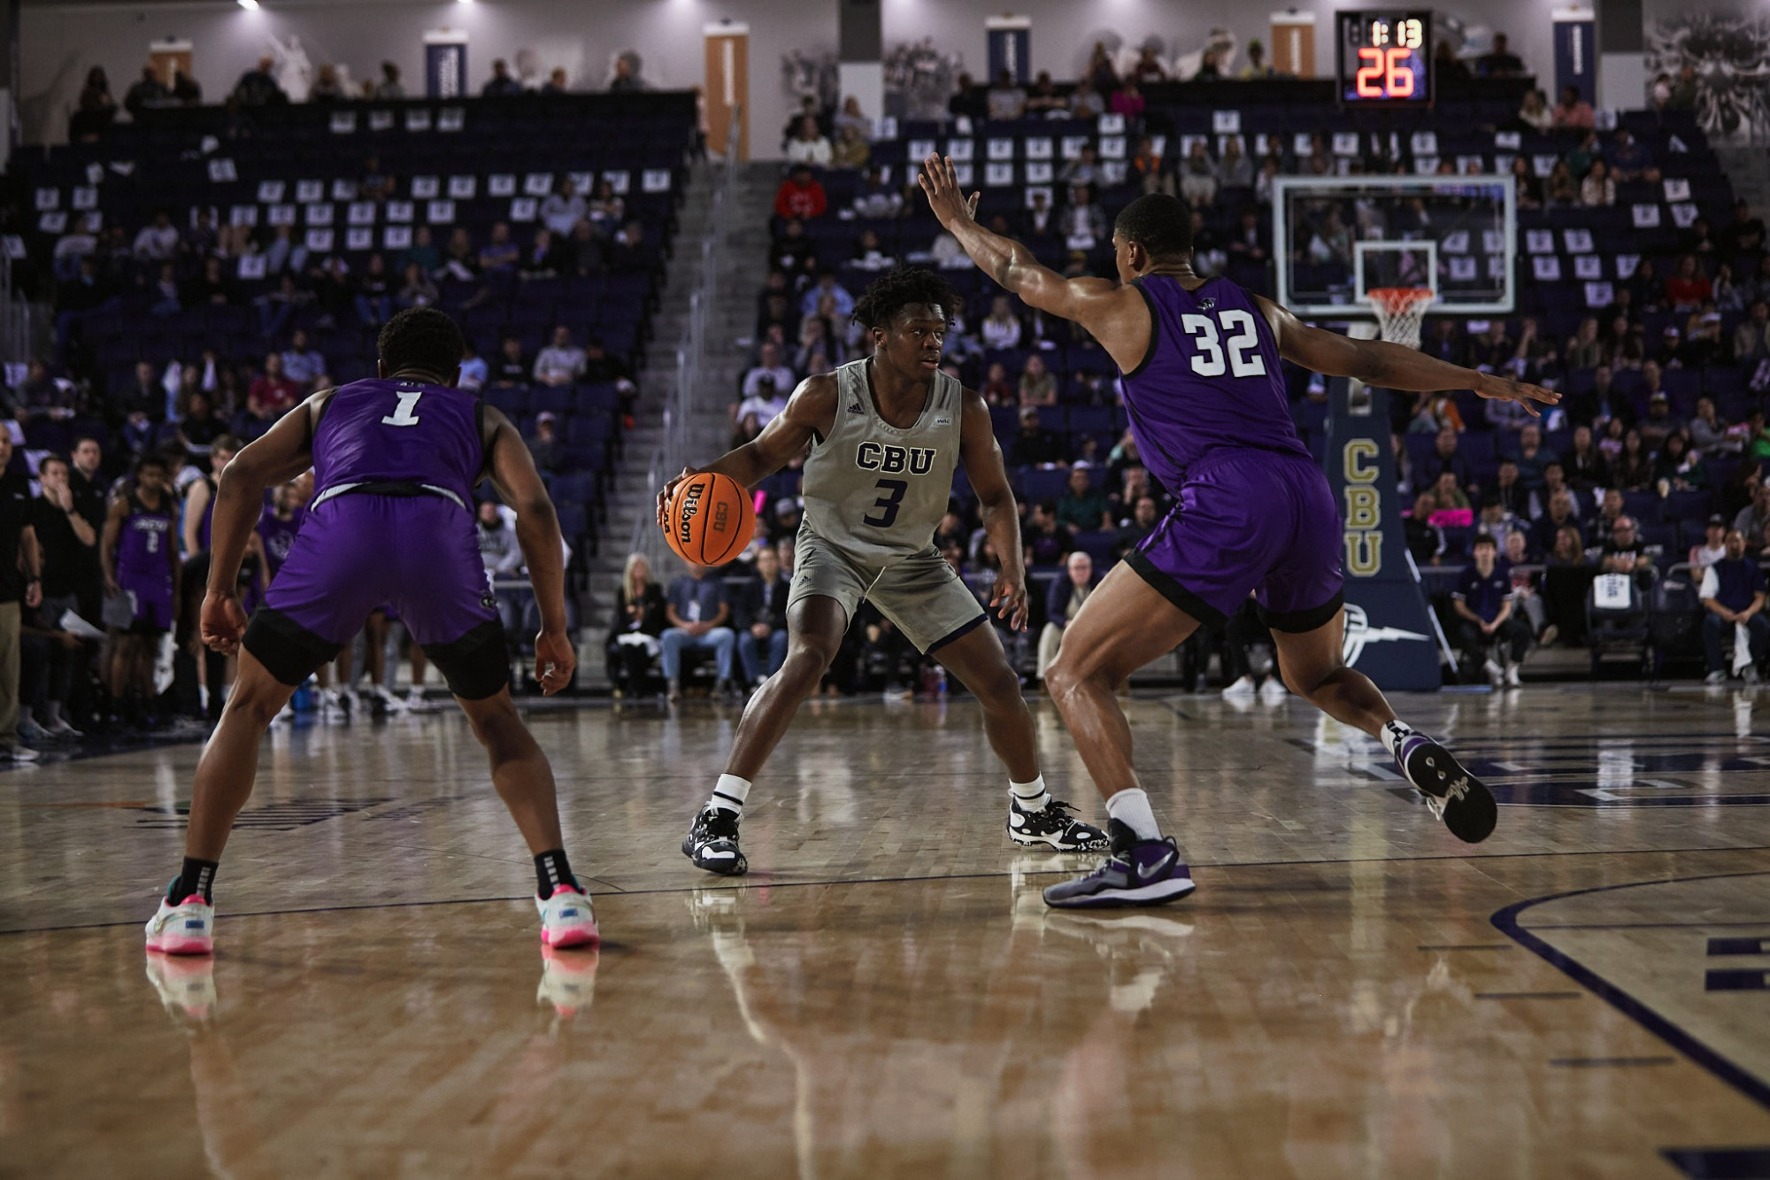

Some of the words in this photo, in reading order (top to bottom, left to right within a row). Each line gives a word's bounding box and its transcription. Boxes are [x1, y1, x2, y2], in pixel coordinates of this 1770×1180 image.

[1372, 19, 1422, 49] 1:13
[1357, 47, 1414, 98] 26
[1181, 309, 1266, 377] 32
[382, 391, 422, 426] 1
[856, 441, 937, 475] CBU
[681, 483, 706, 543] Wilson
[713, 501, 729, 533] CBU
[863, 479, 908, 528] 3
[1344, 438, 1383, 577] CBU
